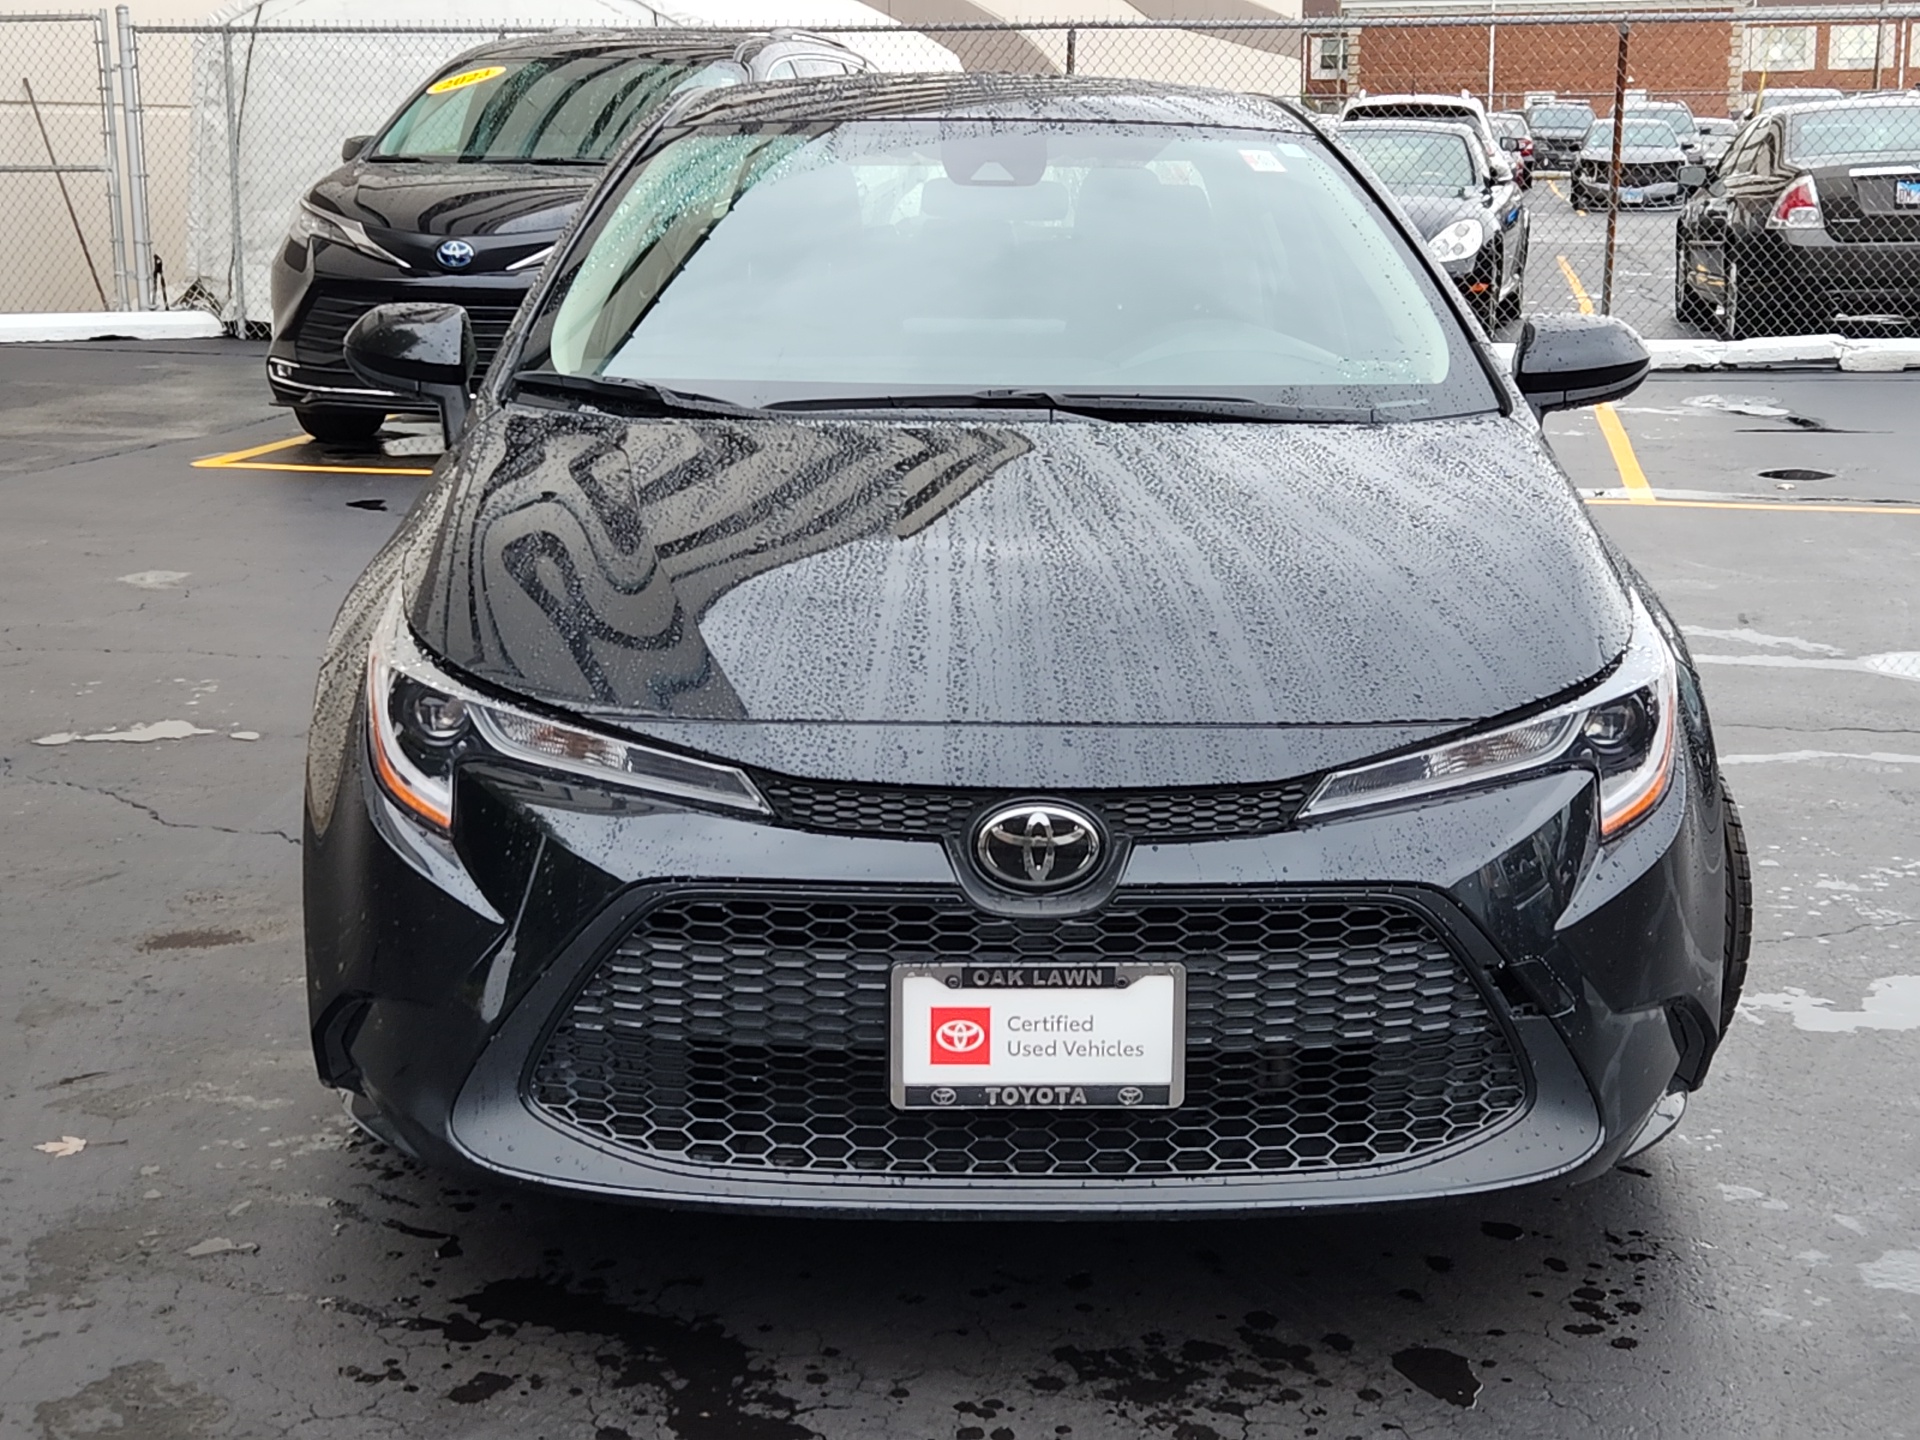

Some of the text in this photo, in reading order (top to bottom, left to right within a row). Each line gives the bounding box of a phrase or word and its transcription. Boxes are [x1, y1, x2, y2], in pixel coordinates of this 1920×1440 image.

[973, 969, 1103, 986] OAK LAWN
[1007, 1015, 1094, 1032] Certified
[1007, 1040, 1144, 1057] Used Vehicles
[985, 1087, 1088, 1105] TOYOTA
